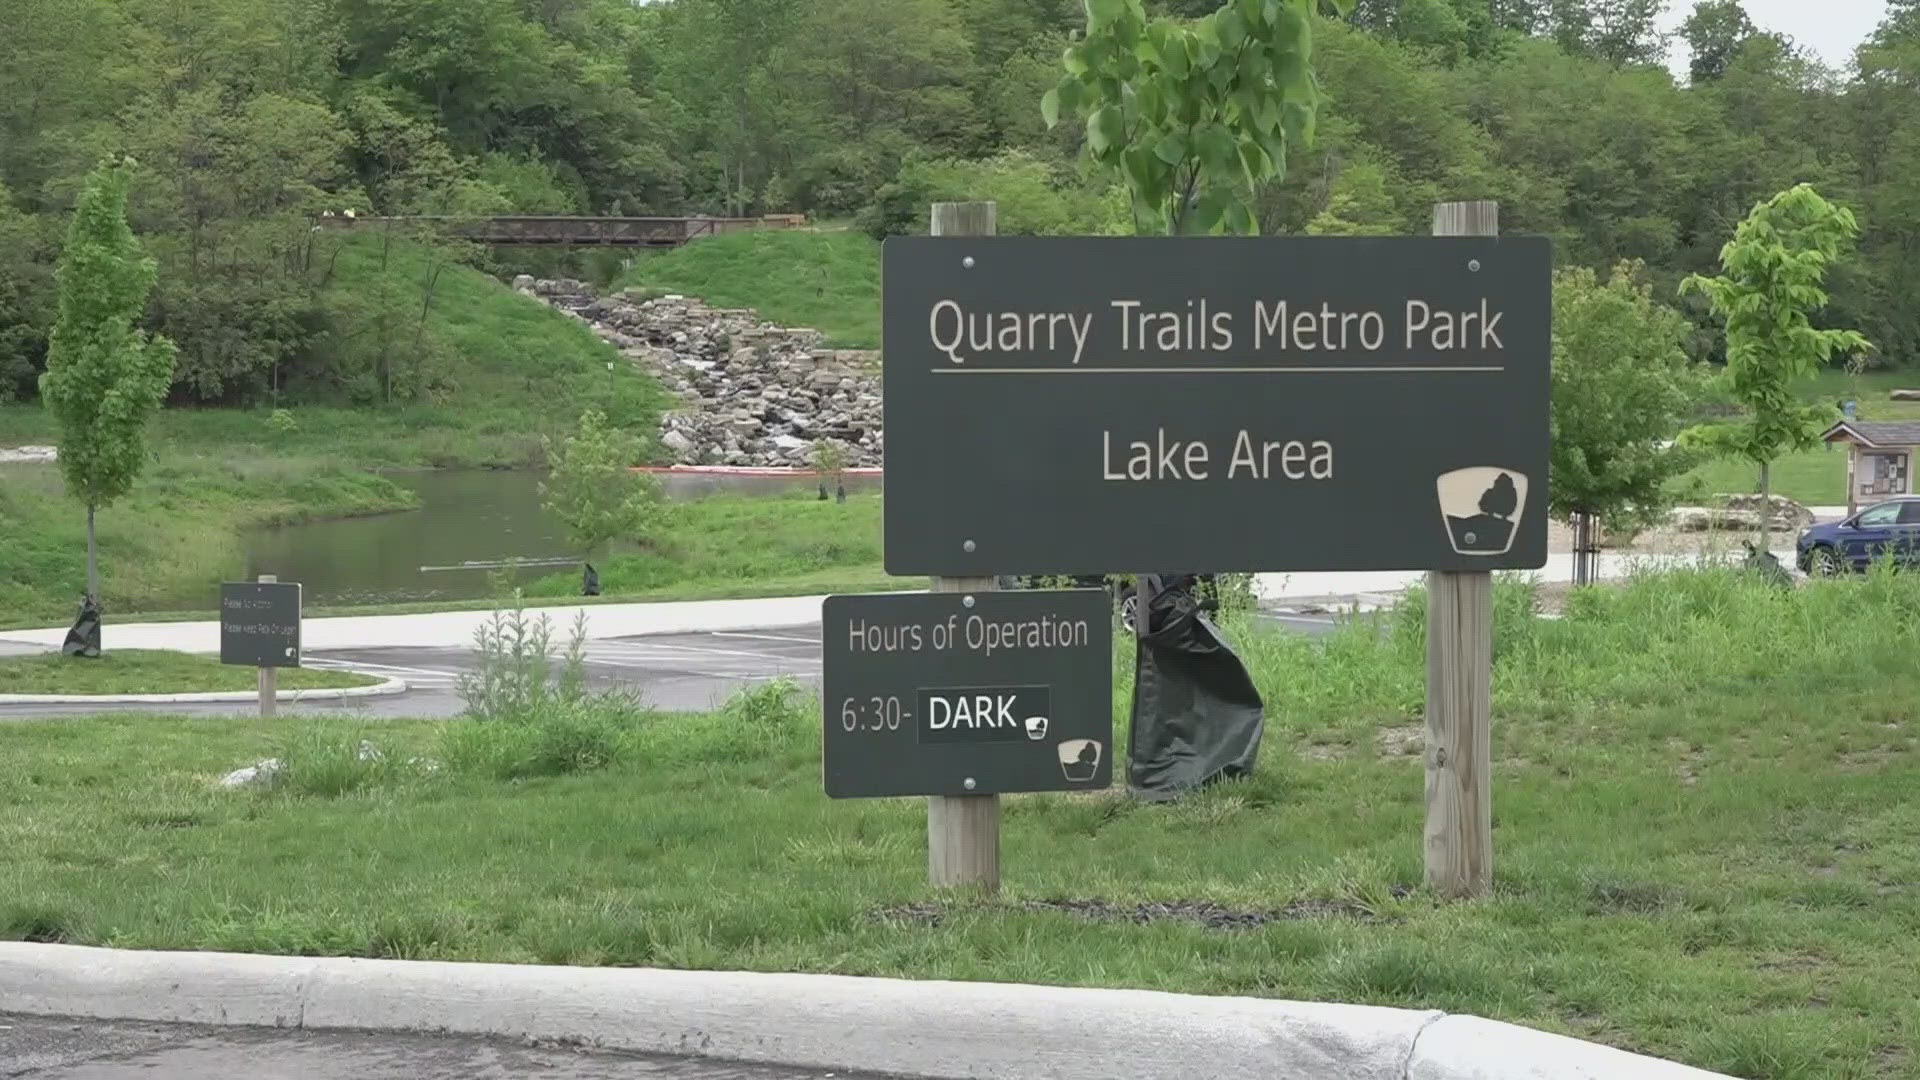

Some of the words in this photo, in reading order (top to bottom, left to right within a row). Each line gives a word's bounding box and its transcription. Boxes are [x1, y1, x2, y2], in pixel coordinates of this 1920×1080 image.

[930, 299, 1093, 364] Quarry
[1111, 298, 1233, 351] Trails
[1254, 300, 1384, 351] Metro
[1406, 298, 1504, 350] Park
[1103, 428, 1209, 480] Lake
[1227, 430, 1333, 479] Area
[849, 618, 922, 651] Hours
[932, 614, 958, 651] of
[965, 613, 1088, 656] Operation
[842, 696, 912, 731] 6:30-
[929, 694, 1017, 729] DARK
